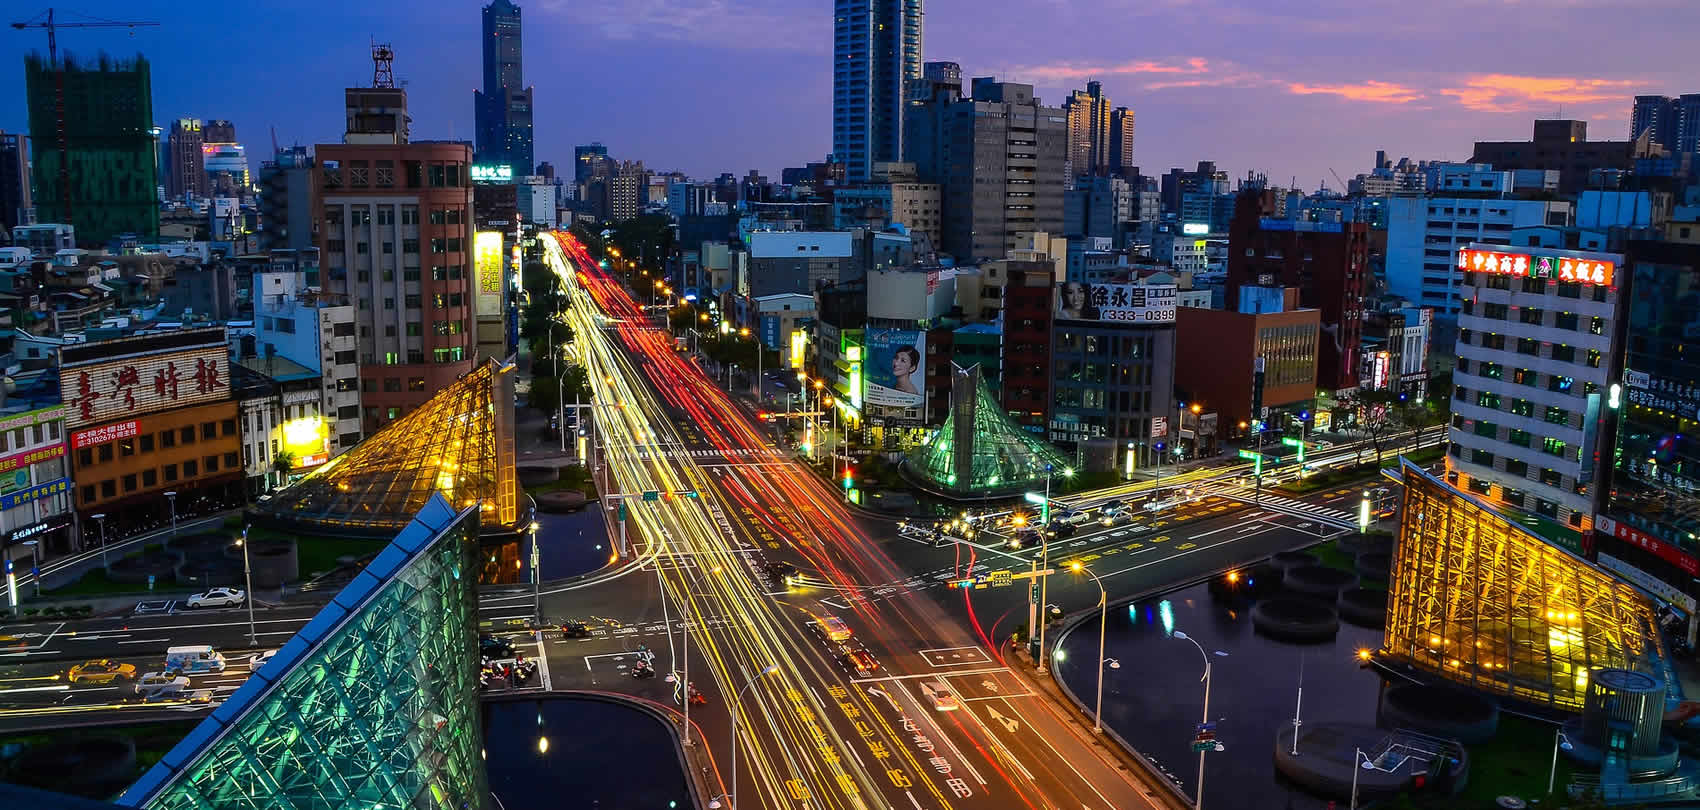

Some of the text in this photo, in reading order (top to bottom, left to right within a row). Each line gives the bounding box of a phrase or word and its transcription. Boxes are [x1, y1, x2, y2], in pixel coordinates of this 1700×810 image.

[1473, 252, 1527, 275] 中央商務
[1560, 260, 1606, 283] 大飯店
[1091, 285, 1146, 308] 徐永昌
[71, 357, 227, 420] 臺灣時報
